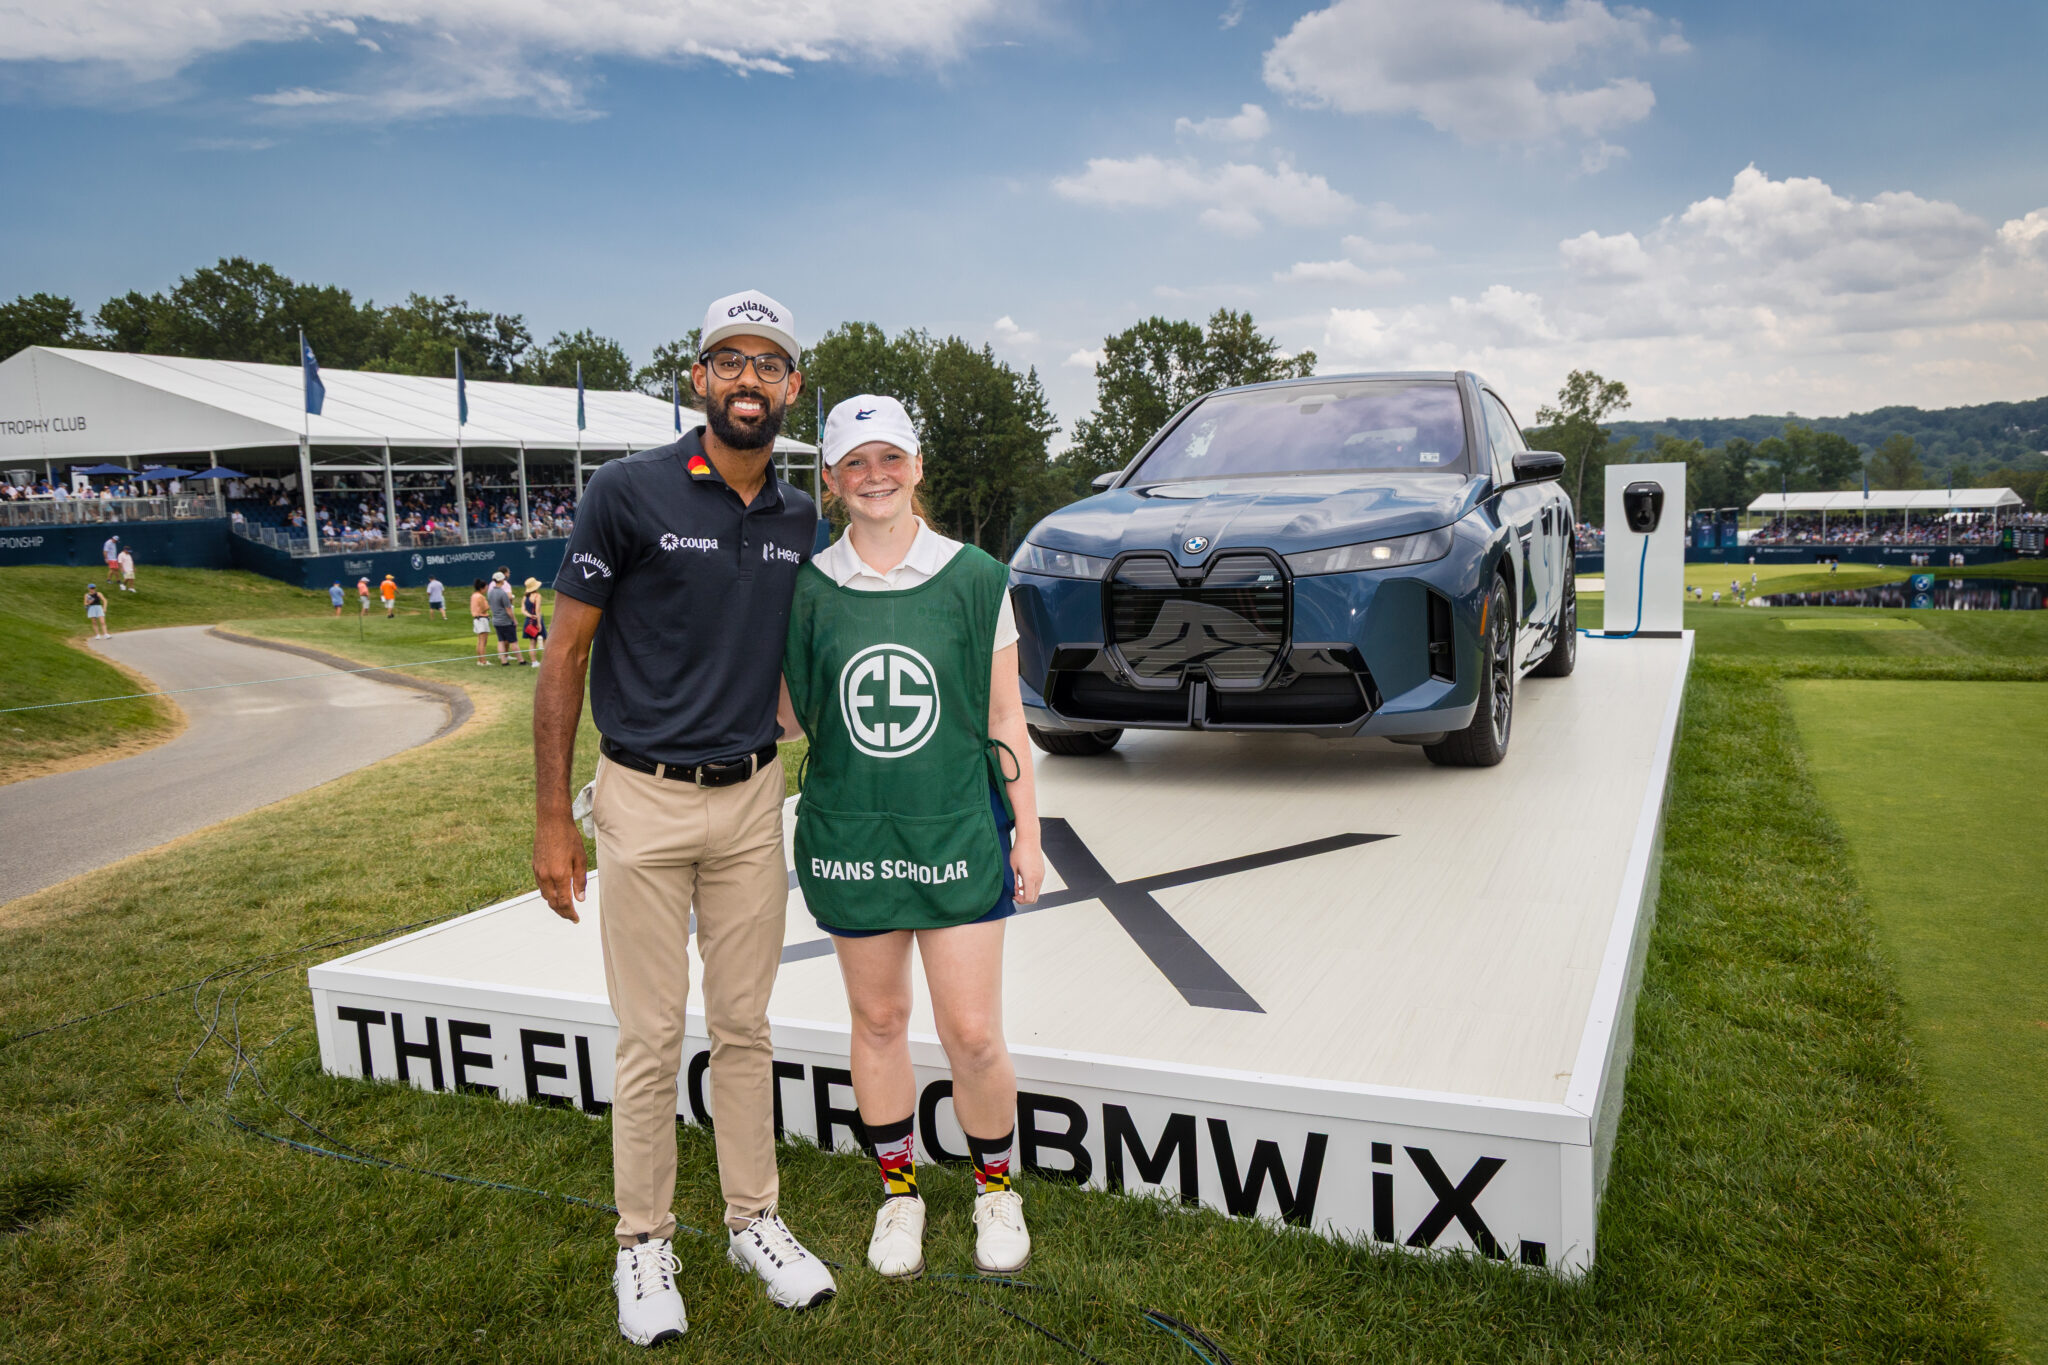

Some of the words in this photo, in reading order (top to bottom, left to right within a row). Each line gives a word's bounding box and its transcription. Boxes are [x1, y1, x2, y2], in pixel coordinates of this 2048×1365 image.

[727, 300, 780, 324] Callaway
[0, 419, 50, 435] TROPHY
[53, 416, 87, 432] CLUB
[679, 537, 719, 552] coupa
[425, 554, 446, 565] BMW
[445, 551, 496, 564] CHAMPIONSHIP
[572, 552, 613, 578] Callaway
[848, 654, 934, 748] ES
[811, 857, 875, 881] EVANS
[880, 859, 969, 885] SCHOLAR
[336, 1005, 500, 1096] THE
[1016, 1090, 1329, 1229] BMW
